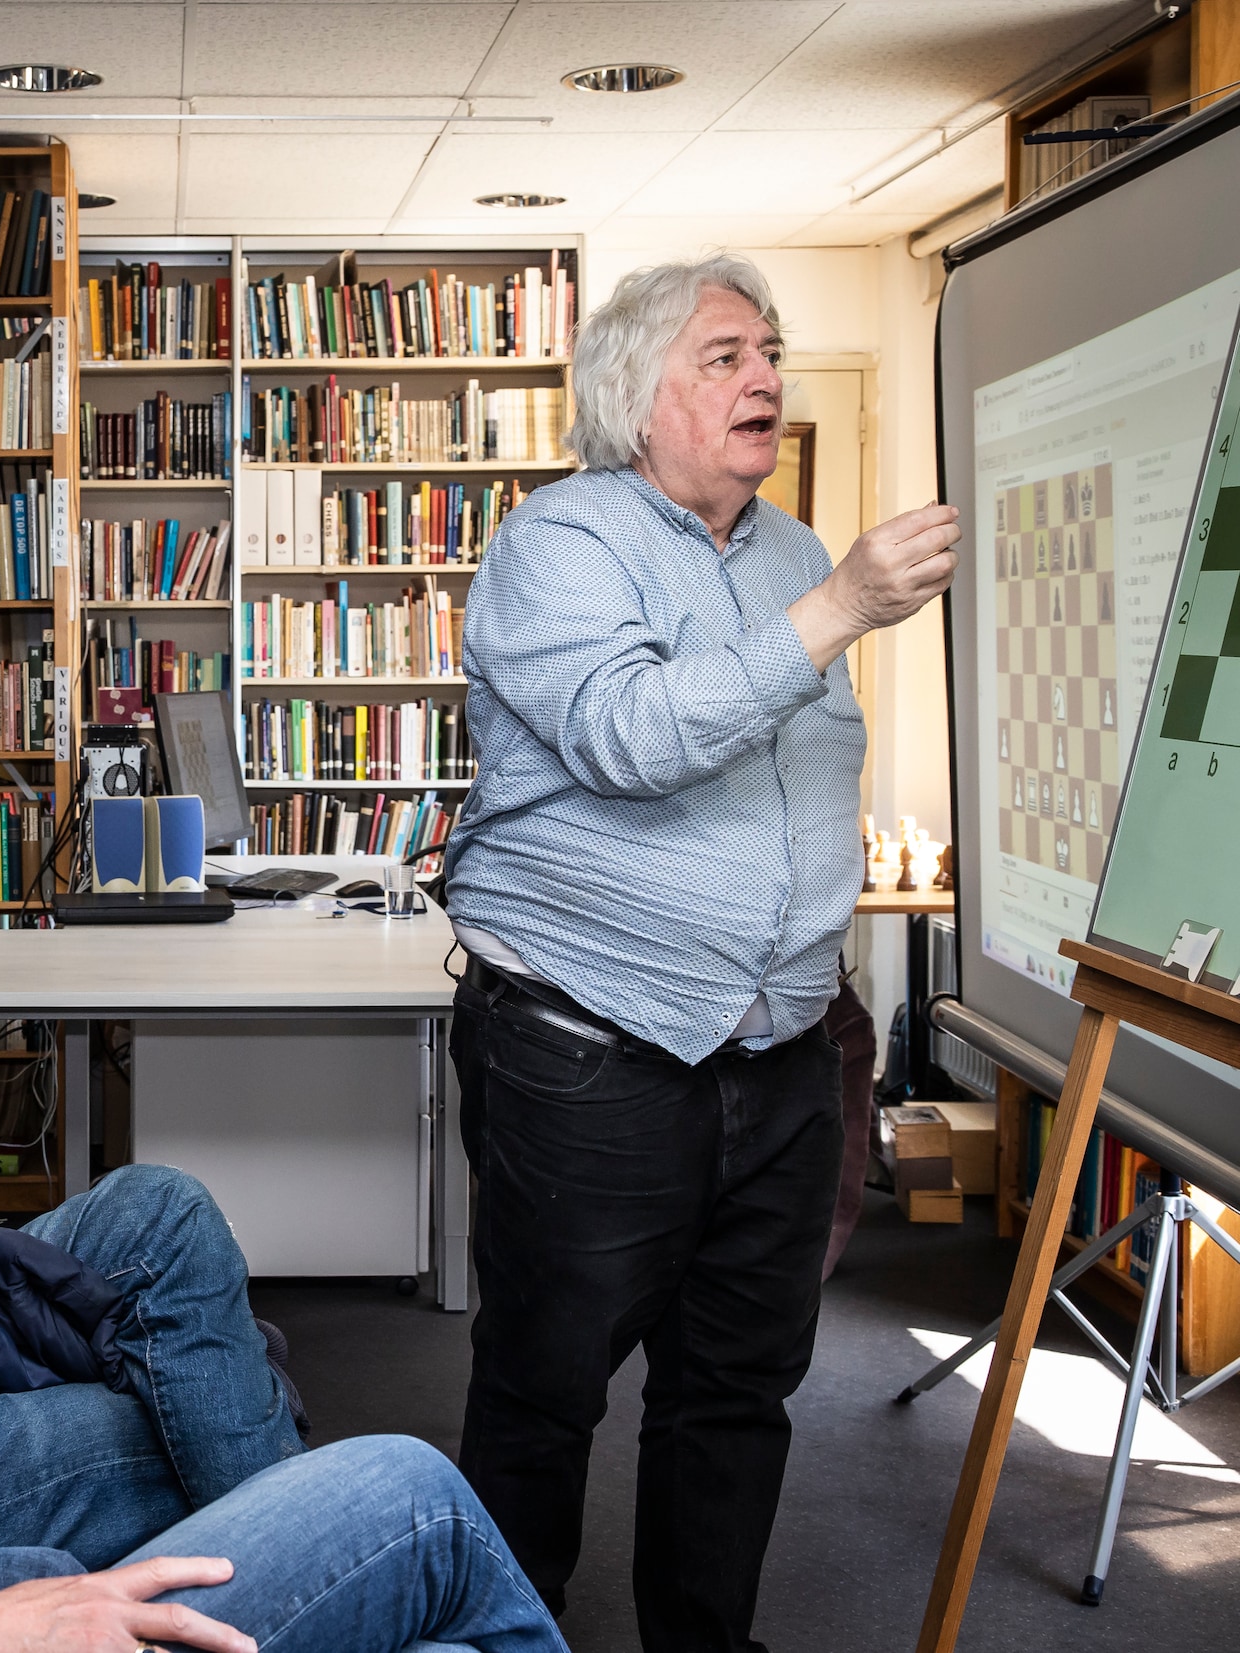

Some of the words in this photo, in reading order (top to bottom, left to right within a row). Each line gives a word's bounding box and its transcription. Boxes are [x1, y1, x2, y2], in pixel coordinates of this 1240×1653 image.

[56, 205, 65, 255] KNSB
[56, 319, 65, 431] NEDERLANDS
[1219, 434, 1231, 458] 4
[15, 500, 24, 513] DE
[16, 516, 25, 535] TOP
[56, 483, 65, 560] VARIOUS
[1198, 517, 1210, 542] 3
[17, 537, 26, 555] 500
[1178, 601, 1190, 625] 2
[1162, 684, 1170, 707] 1
[58, 669, 67, 761] VARIOUS
[1168, 751, 1178, 771] a
[1207, 752, 1218, 777] b
